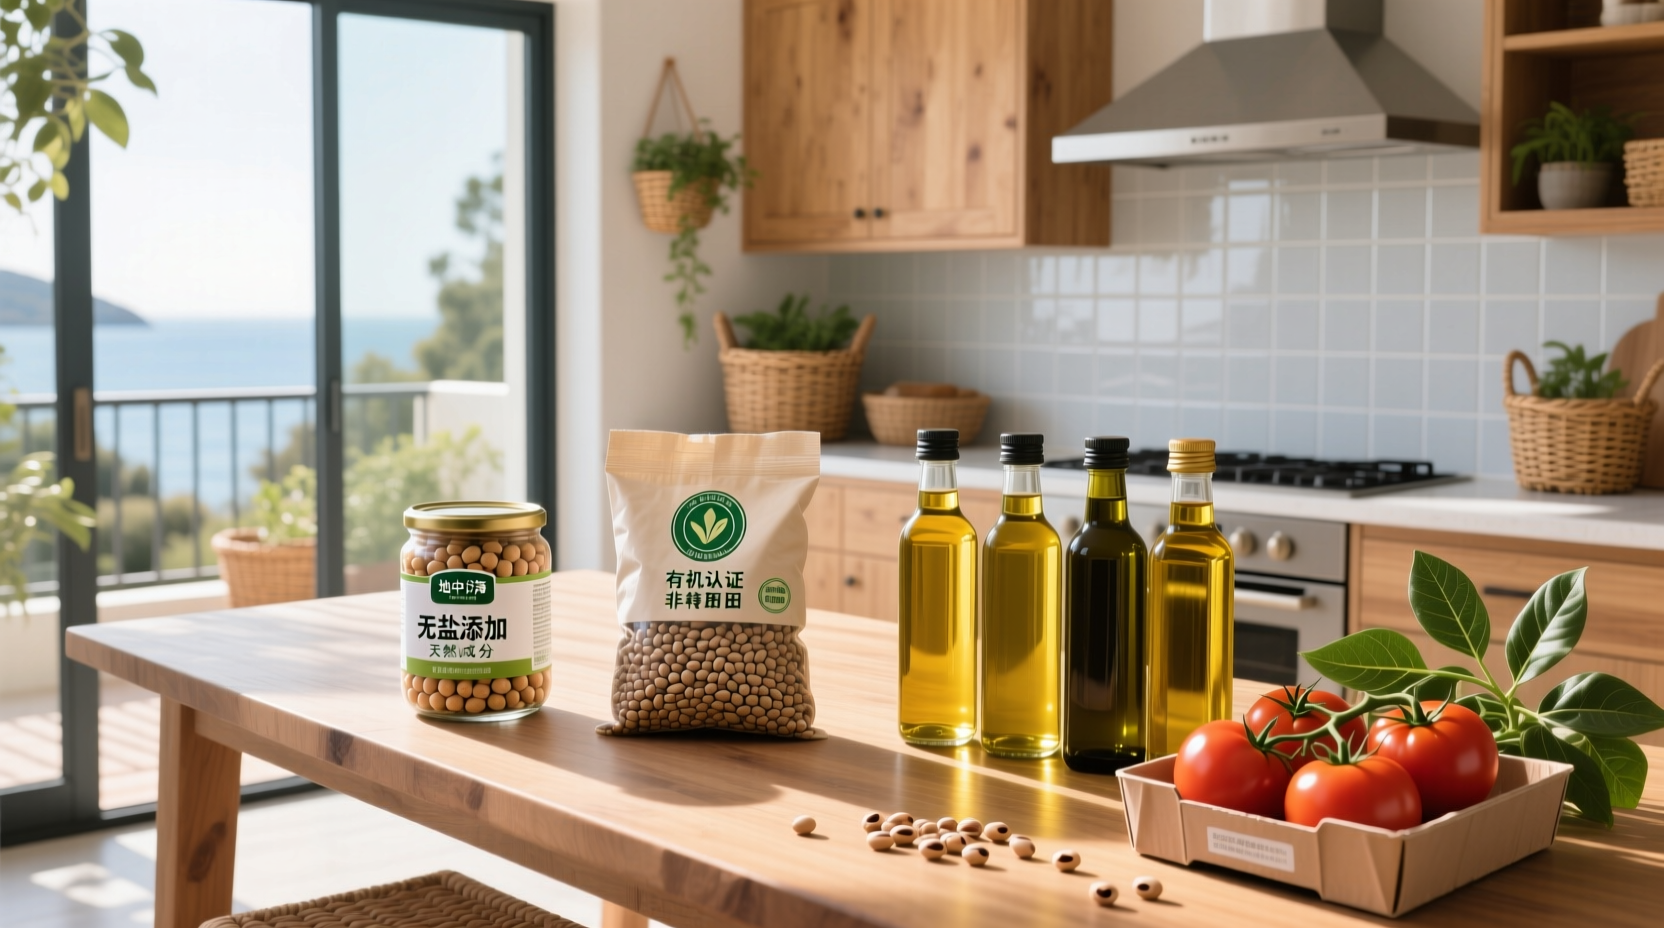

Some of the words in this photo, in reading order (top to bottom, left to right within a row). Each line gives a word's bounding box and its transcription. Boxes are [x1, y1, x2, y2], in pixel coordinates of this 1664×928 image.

[666, 569, 744, 589] 有机认证
[417, 614, 507, 641] 无盐添加
